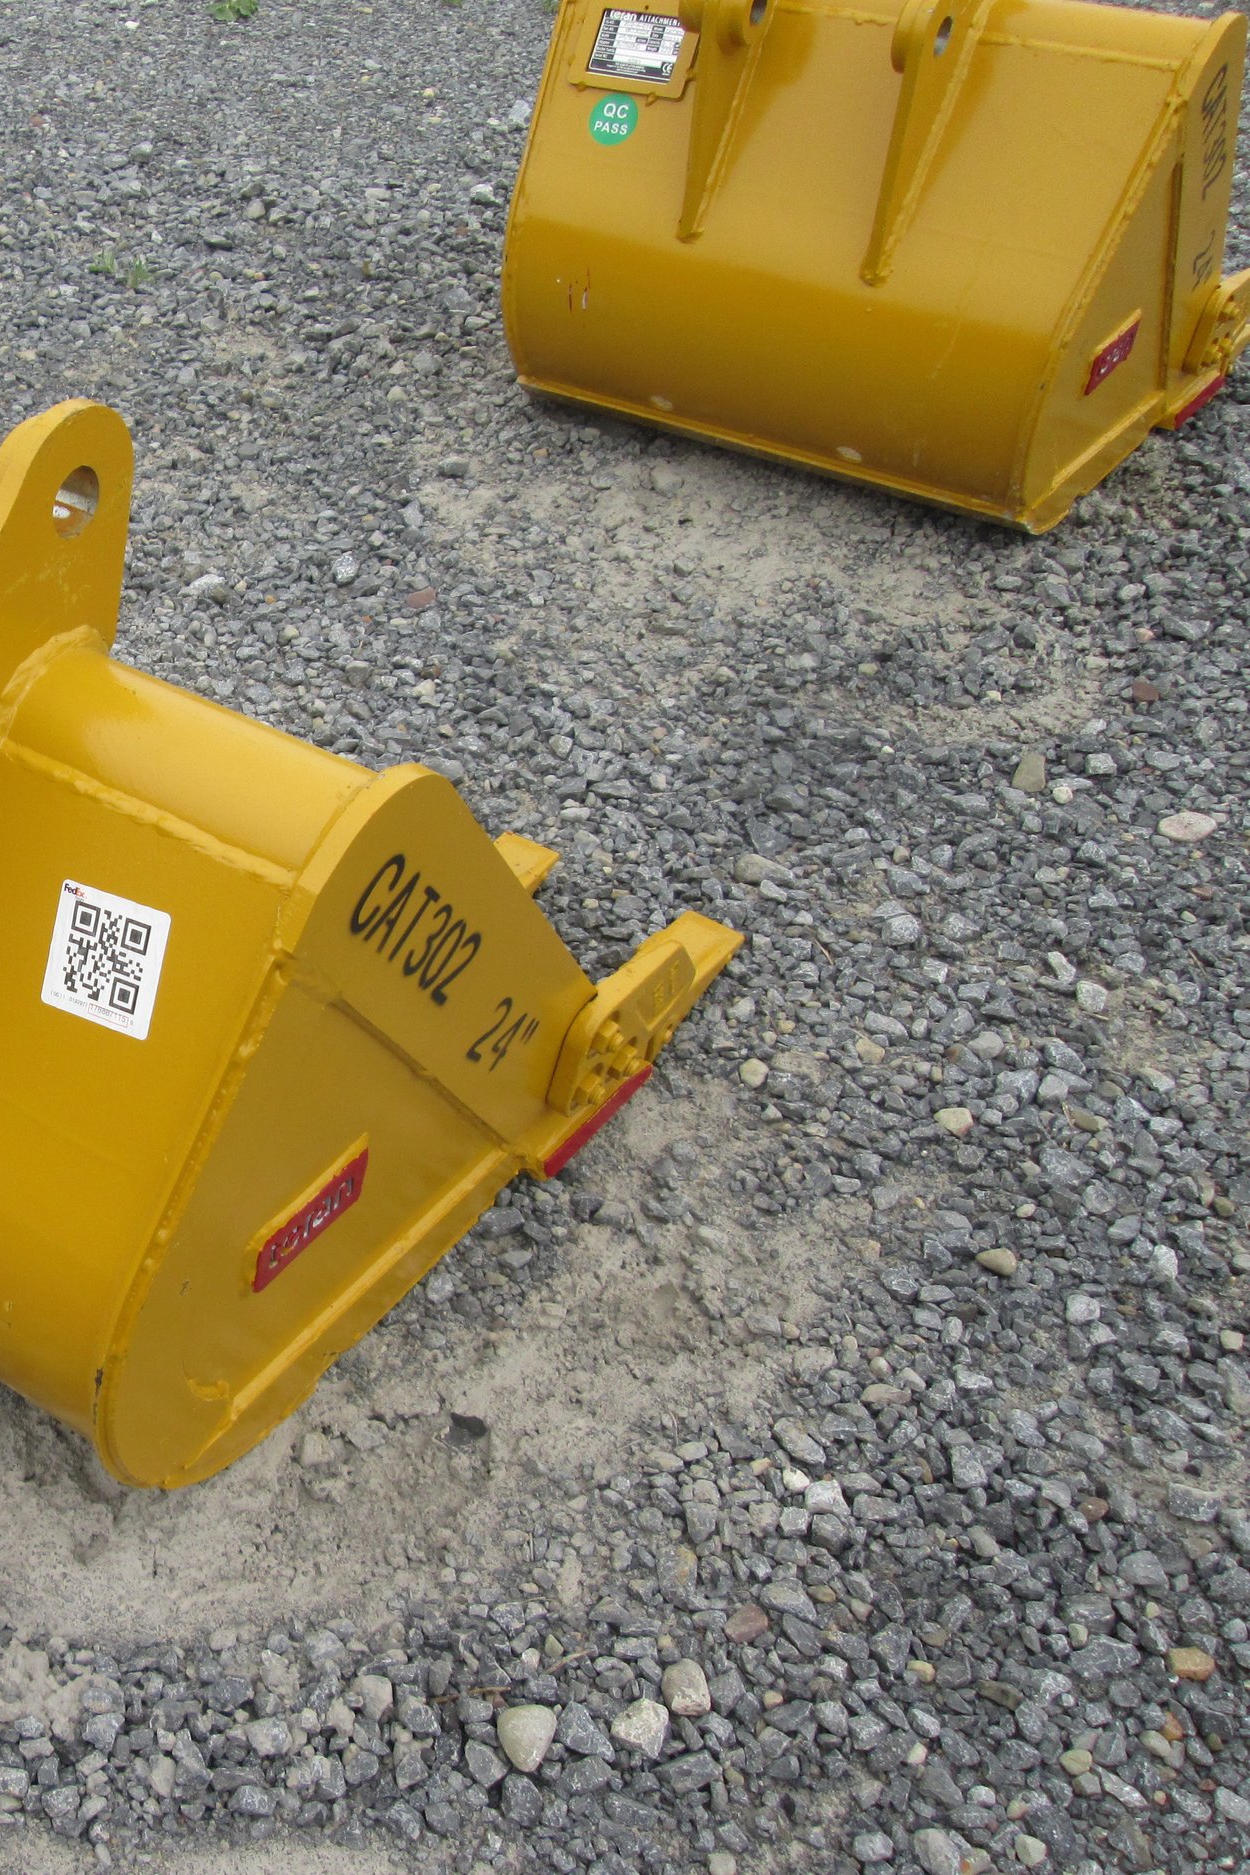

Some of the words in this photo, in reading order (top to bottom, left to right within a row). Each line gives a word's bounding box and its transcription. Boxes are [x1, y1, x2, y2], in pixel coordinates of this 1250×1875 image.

[610, 9, 637, 22] teran
[603, 103, 629, 118] QC
[594, 120, 628, 135] PASS
[64, 883, 85, 898] FedEx
[350, 854, 482, 1007] CAT302
[466, 997, 540, 1072] 24"
[269, 1177, 353, 1269] teran
